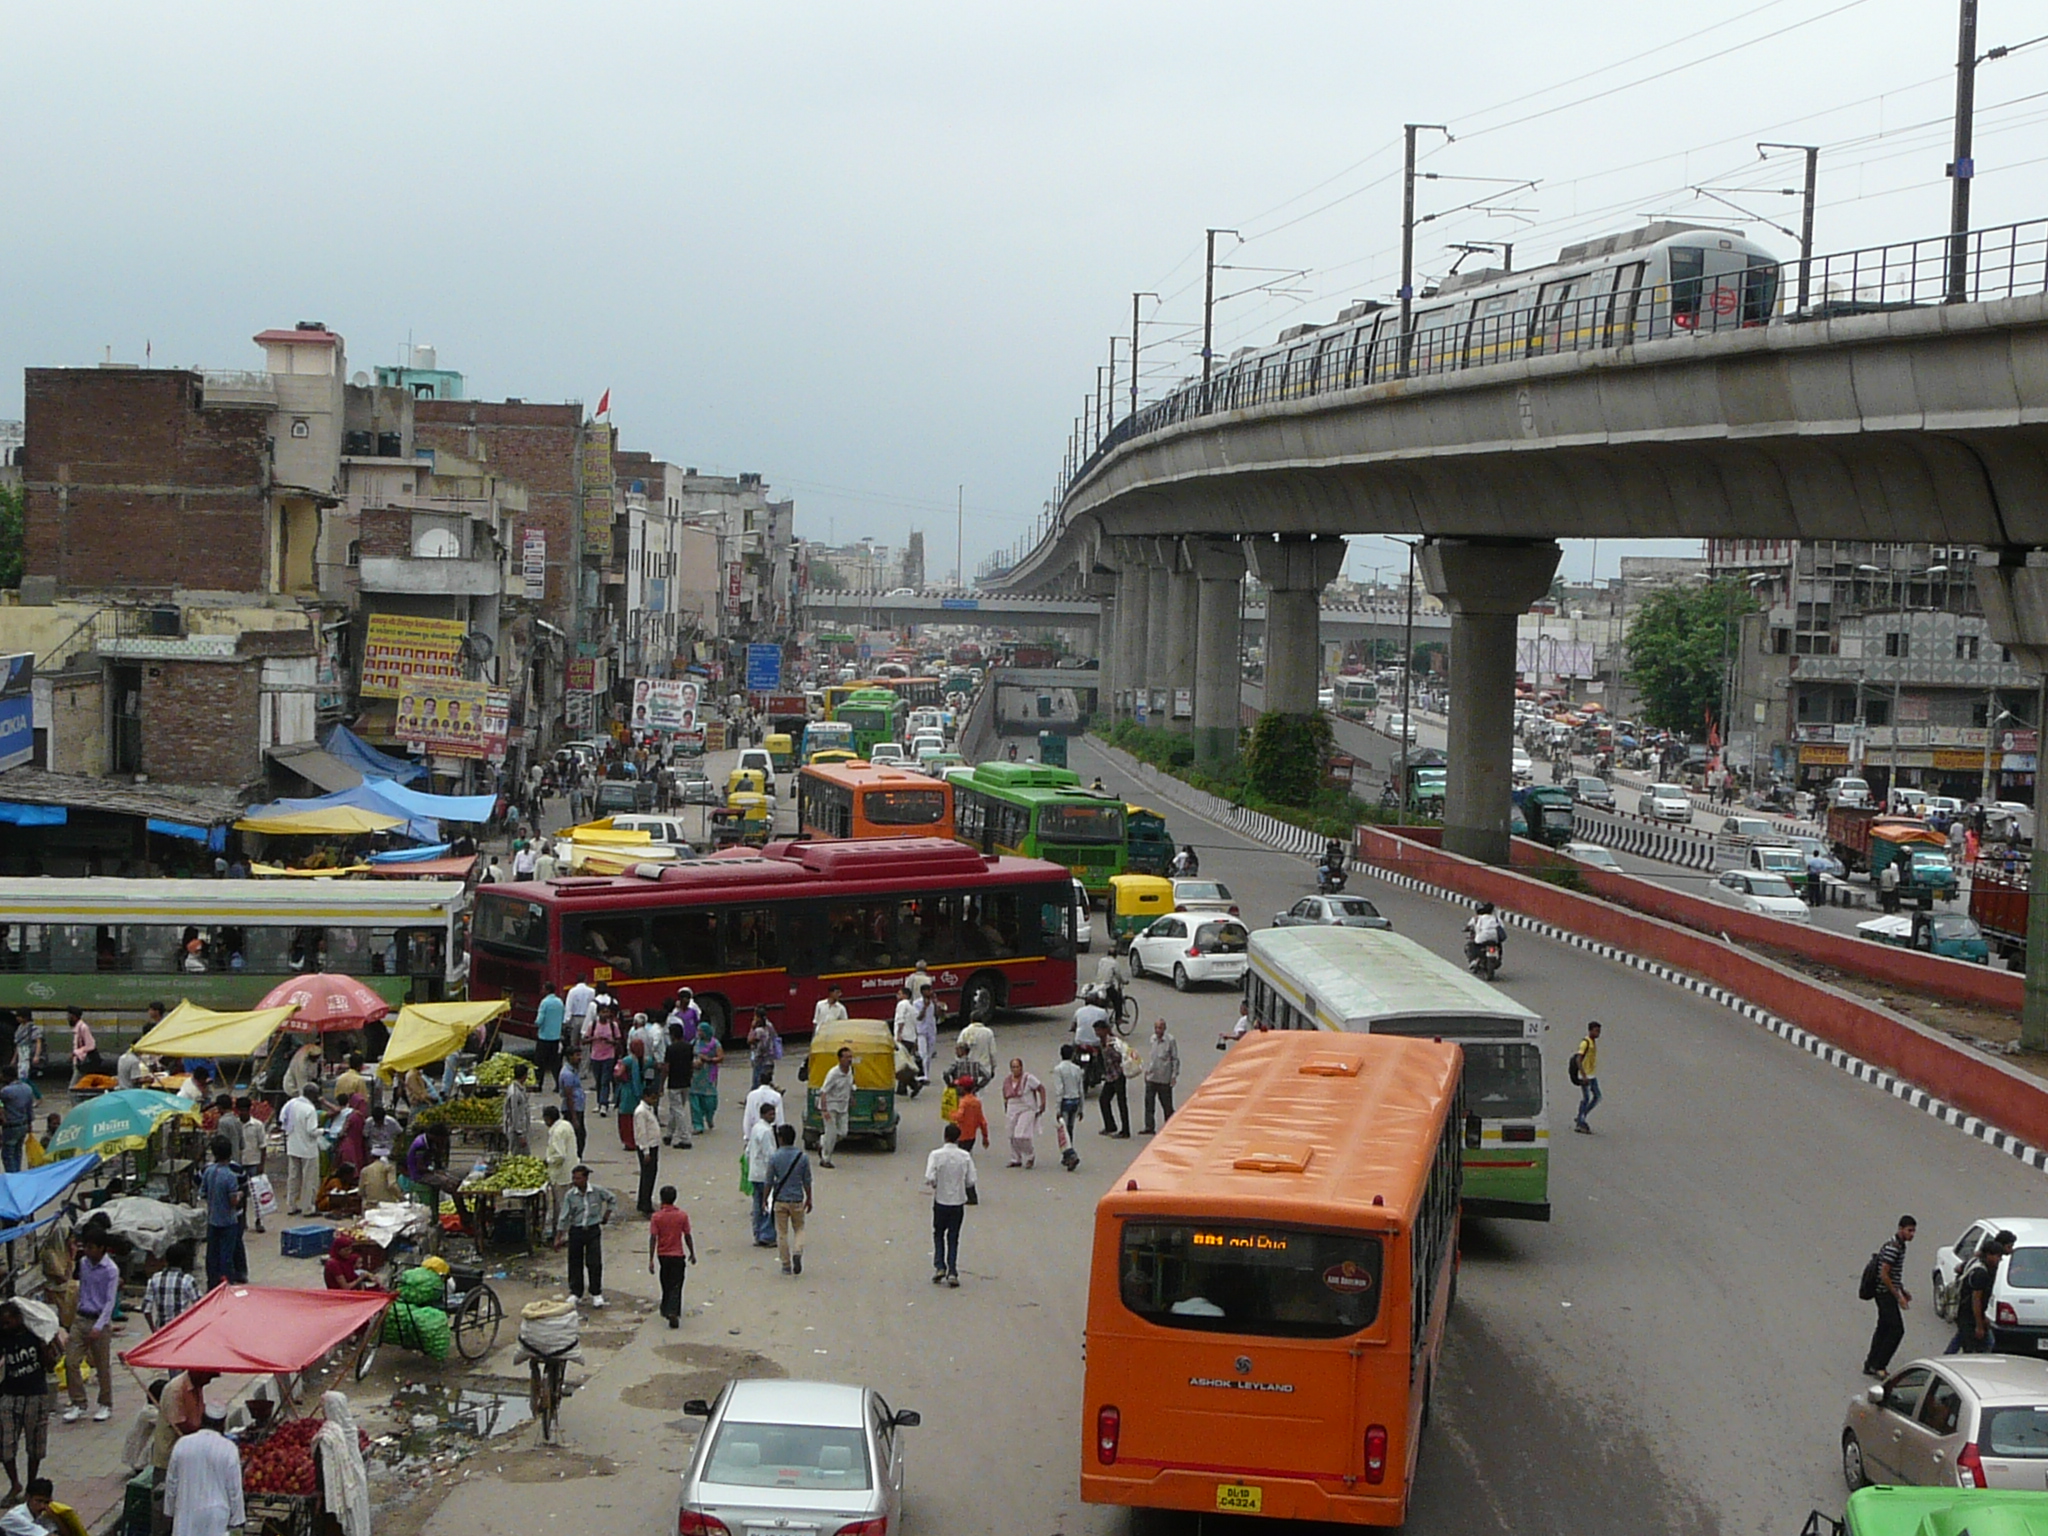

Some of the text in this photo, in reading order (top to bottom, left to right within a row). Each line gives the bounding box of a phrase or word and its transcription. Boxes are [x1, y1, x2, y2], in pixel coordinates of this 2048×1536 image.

[0, 714, 27, 738] OKIA
[862, 977, 903, 989] Delhi Transport
[1190, 1377, 1294, 1393] ASHOK LEYLAND
